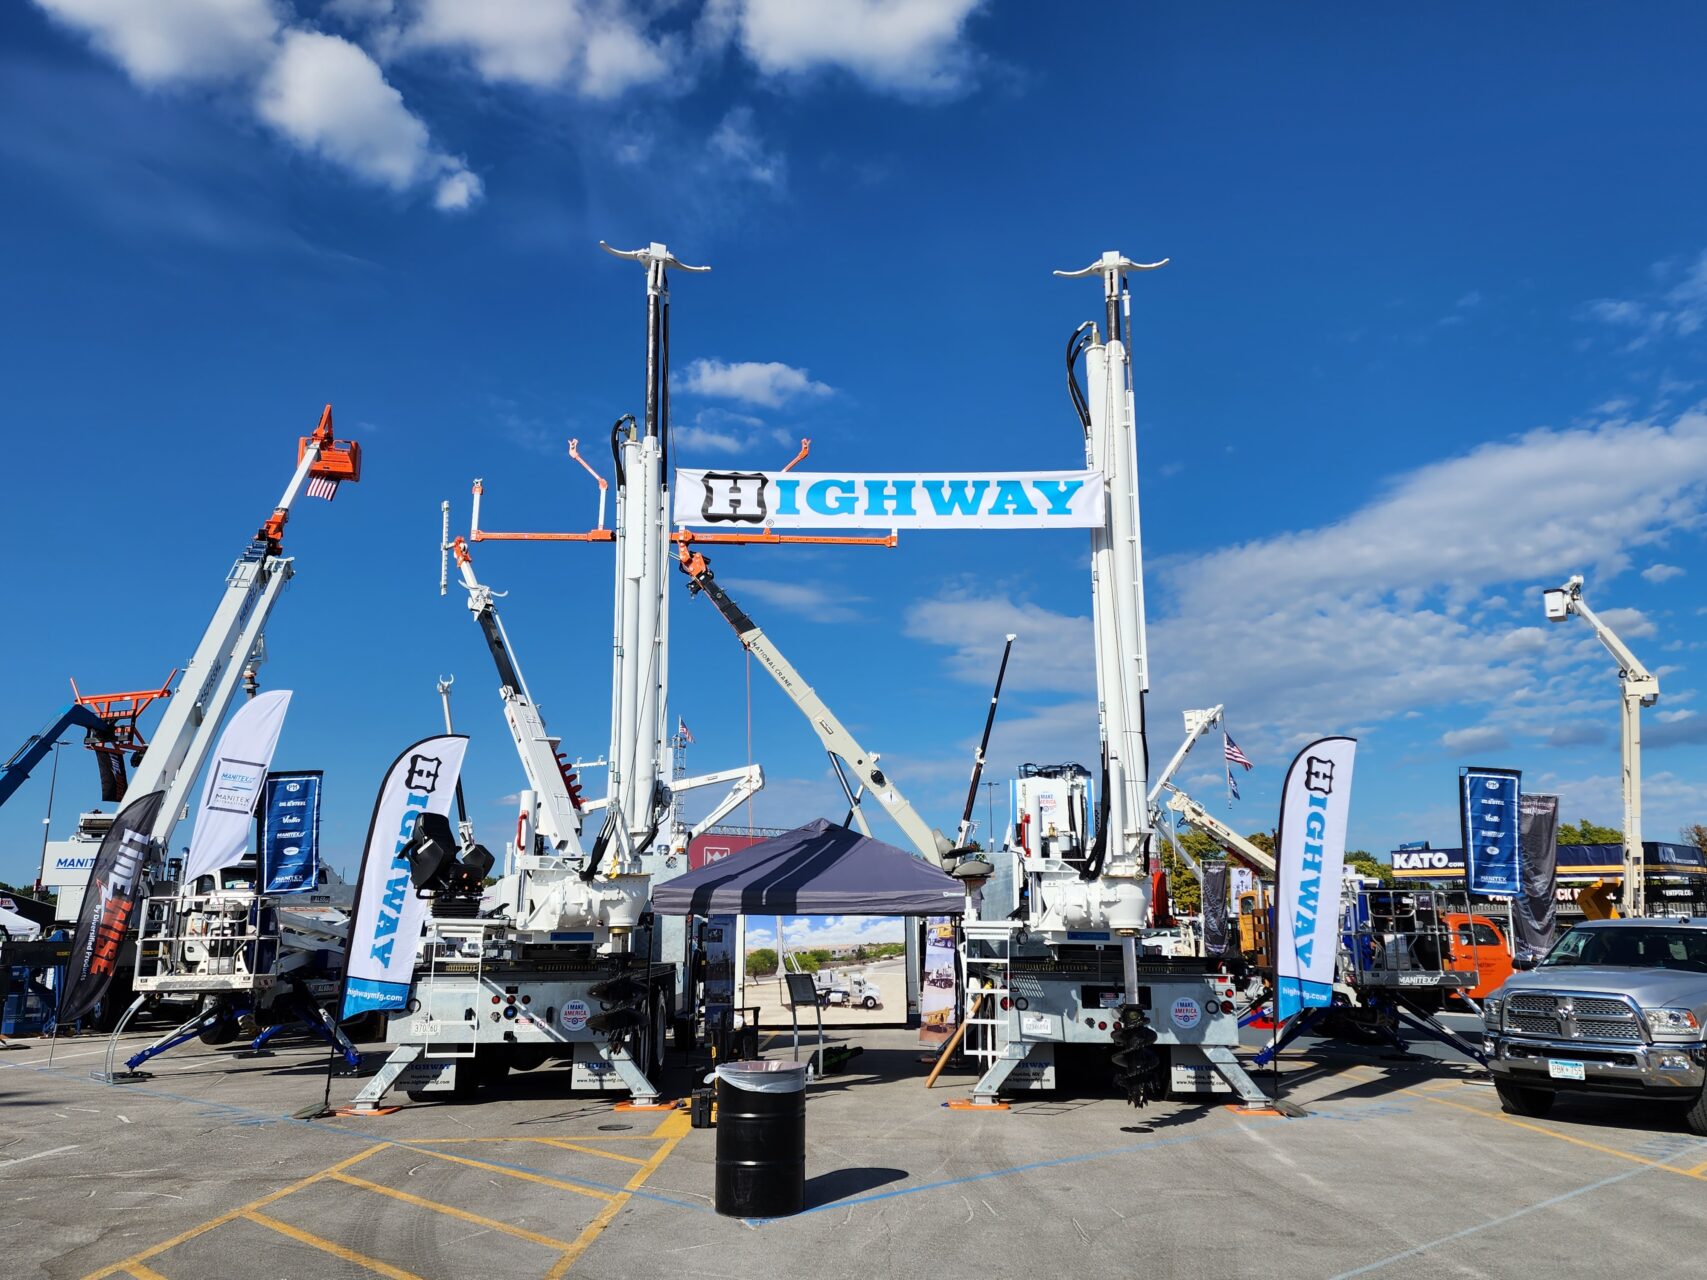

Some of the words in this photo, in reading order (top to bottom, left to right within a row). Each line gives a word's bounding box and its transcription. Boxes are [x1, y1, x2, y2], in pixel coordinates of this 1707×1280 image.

[701, 471, 1084, 524] HIGHWAY
[752, 640, 776, 671] NATIONAL
[775, 668, 793, 688] CRANE
[215, 793, 250, 803] MANITEX
[56, 857, 97, 868] MANIT
[1295, 755, 1335, 969] HIGHWAY
[1392, 852, 1449, 869] KATO
[90, 897, 135, 977] WISE
[1399, 977, 1432, 985] MANITEX
[346, 987, 403, 1003] highwaymfg.com
